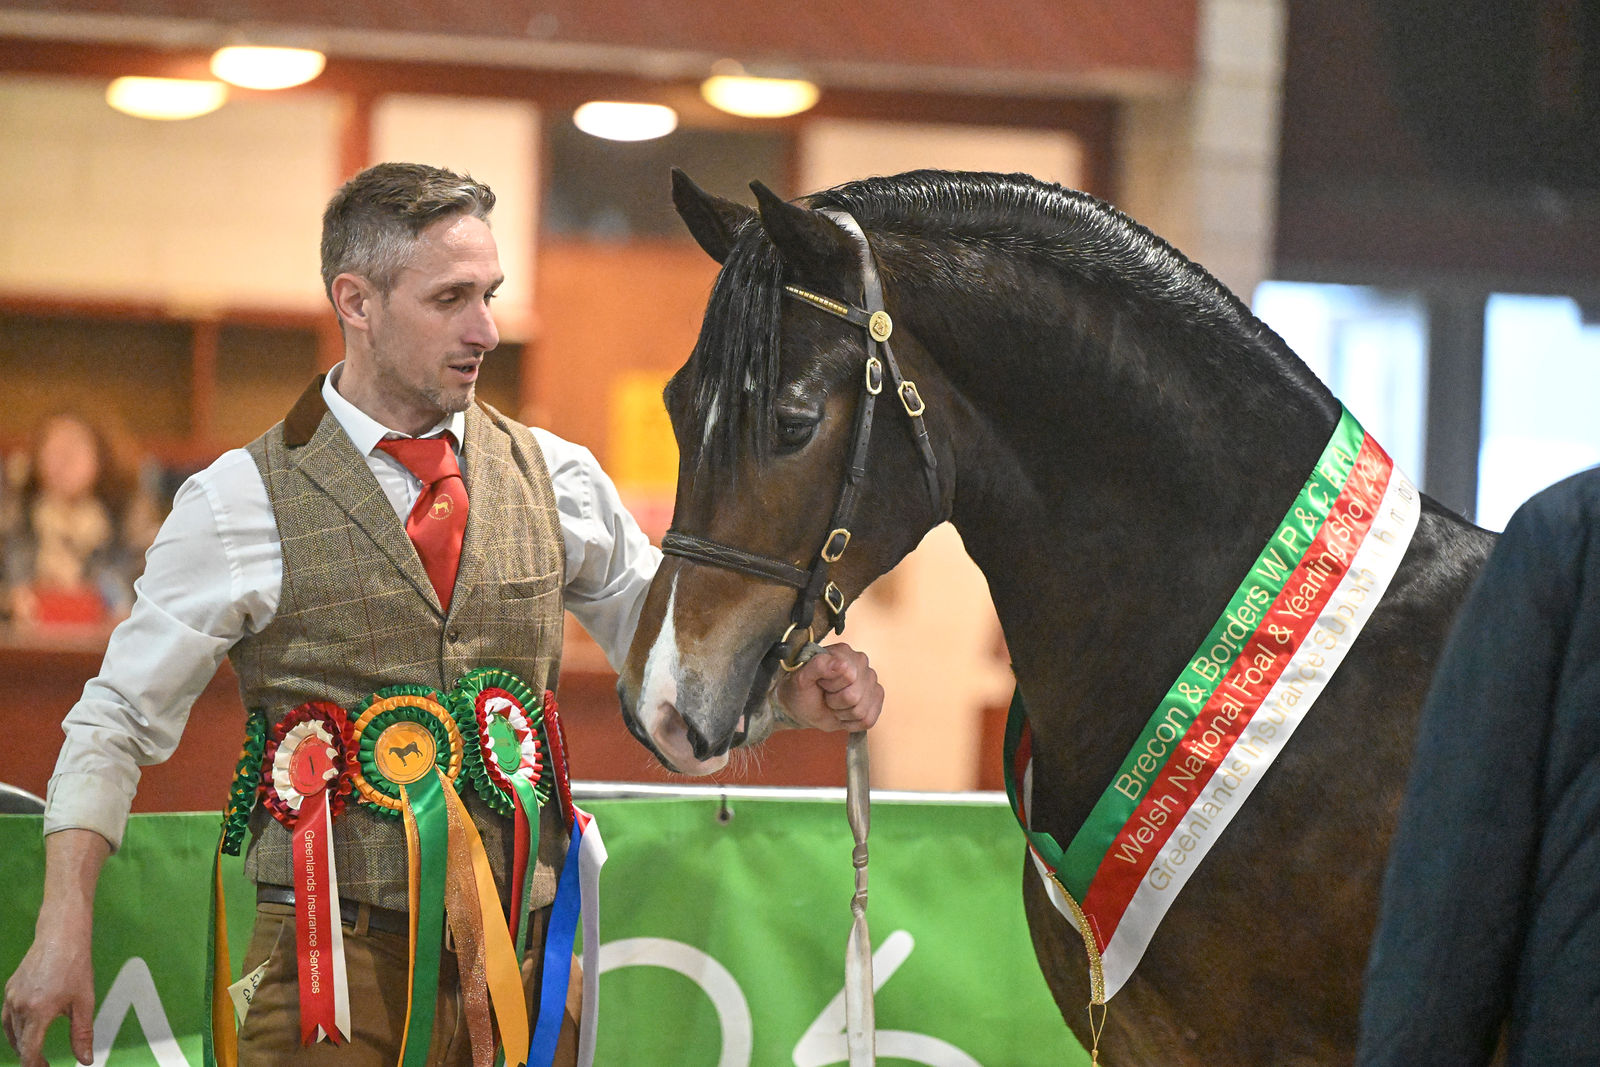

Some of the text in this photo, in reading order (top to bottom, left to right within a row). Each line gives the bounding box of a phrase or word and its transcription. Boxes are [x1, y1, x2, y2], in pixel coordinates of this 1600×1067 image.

[1330, 485, 1369, 542] Show
[1278, 541, 1348, 619] Yearling
[1114, 706, 1188, 801] Brecon
[1178, 682, 1206, 704] &
[1192, 585, 1269, 682] Borders
[1256, 548, 1289, 582] W
[1278, 526, 1299, 554] P
[1295, 507, 1319, 529] &
[1308, 483, 1329, 508] C
[1231, 644, 1277, 697] Foal
[1268, 624, 1294, 645] &
[1149, 756, 1250, 891] Greenlands
[1240, 652, 1325, 759] Insurance
[1313, 557, 1382, 651] Suprem
[1168, 692, 1245, 792] National
[1114, 794, 1179, 865] Welsh
[304, 830, 320, 994] Greenlands Insurance Services
